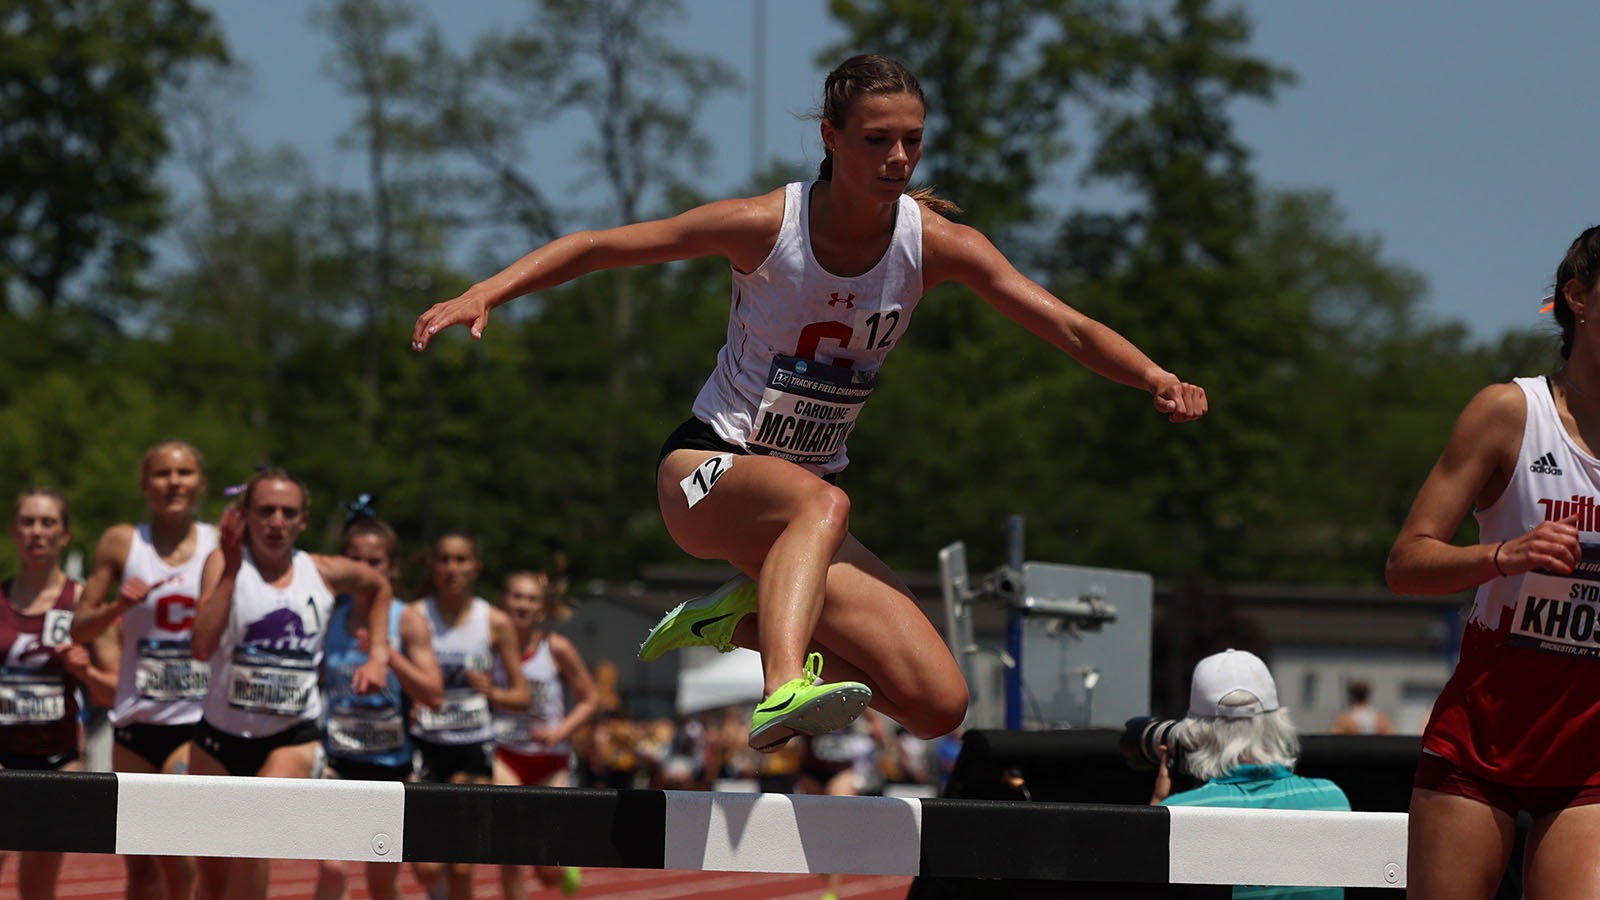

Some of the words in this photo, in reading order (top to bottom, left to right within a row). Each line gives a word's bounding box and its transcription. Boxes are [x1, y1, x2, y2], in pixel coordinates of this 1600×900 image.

[865, 310, 901, 350] 12
[790, 376, 811, 389] TRACK
[811, 381, 818, 390] &
[817, 383, 837, 394] FIELD
[794, 400, 850, 420] CAROLINE
[755, 411, 854, 452] MCMARTI
[692, 457, 724, 495] 12
[1529, 464, 1563, 476] adidas
[1569, 583, 1600, 603] SYD
[51, 615, 68, 644] 6
[1577, 648, 1589, 656] NY
